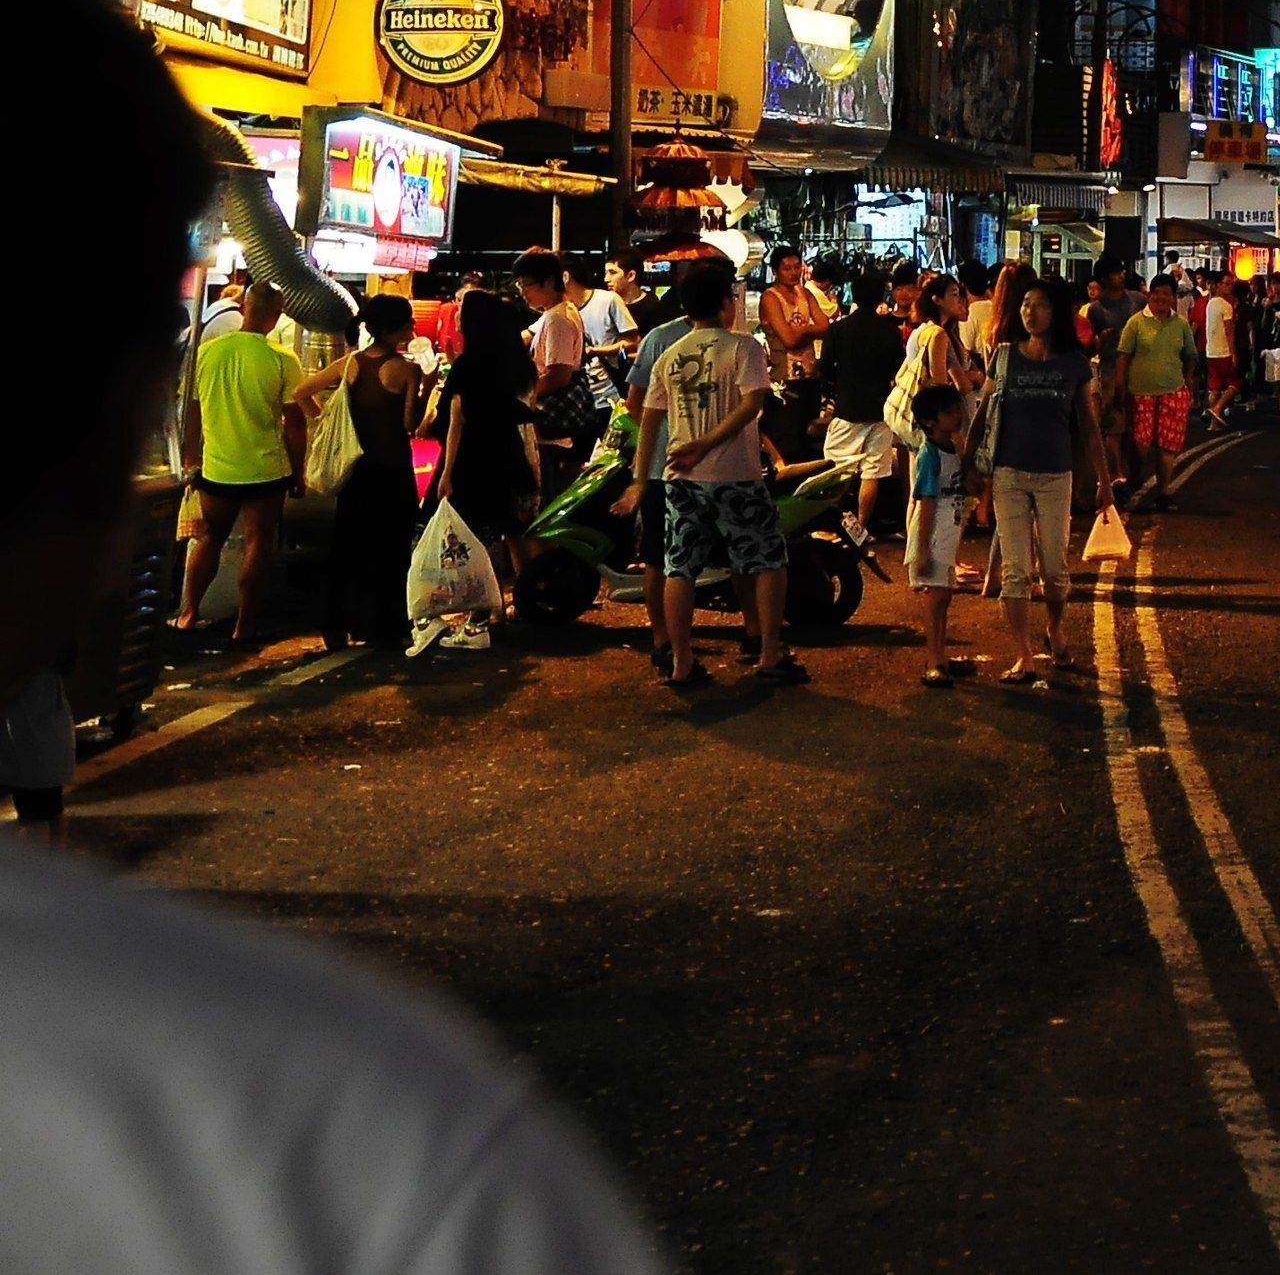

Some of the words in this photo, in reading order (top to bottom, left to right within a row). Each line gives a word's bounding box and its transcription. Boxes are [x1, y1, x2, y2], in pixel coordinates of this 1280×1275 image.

[390, 9, 490, 30] Heineken
[396, 42, 440, 71] PREMIUM
[442, 41, 482, 71] QUALITY
